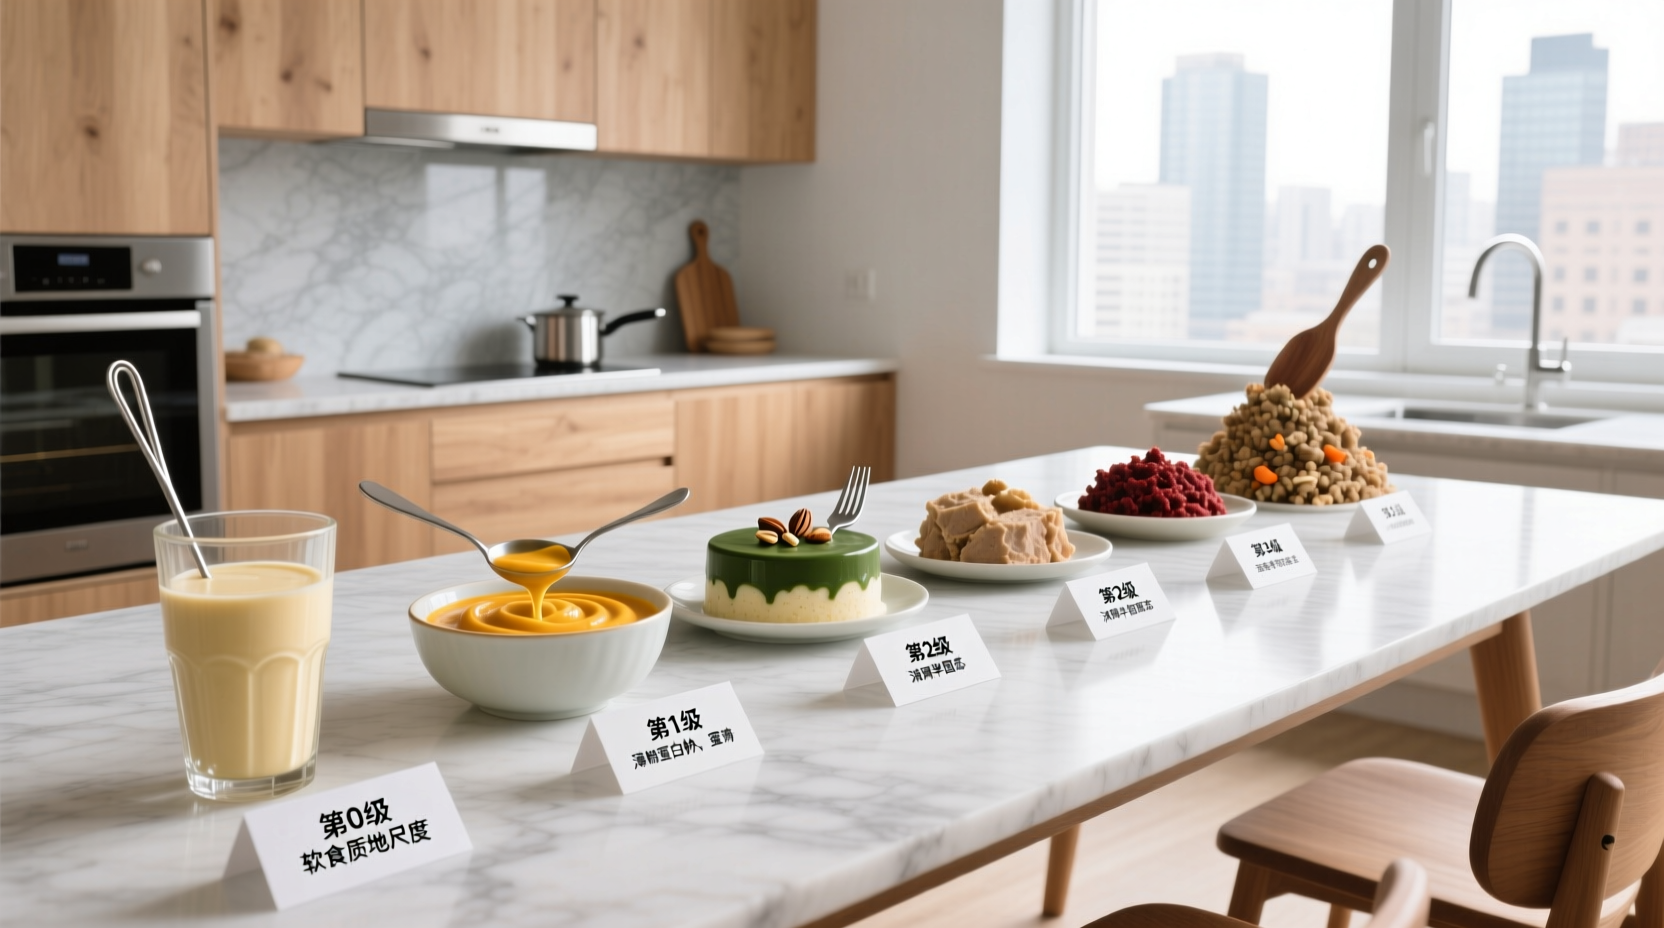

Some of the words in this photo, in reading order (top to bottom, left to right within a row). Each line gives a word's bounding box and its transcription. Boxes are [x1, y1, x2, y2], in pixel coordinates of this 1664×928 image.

[905, 635, 954, 663] 第2级
[646, 707, 704, 742] 第1级
[319, 797, 393, 840] 第0级
[299, 818, 432, 876] 软食质地尺度
